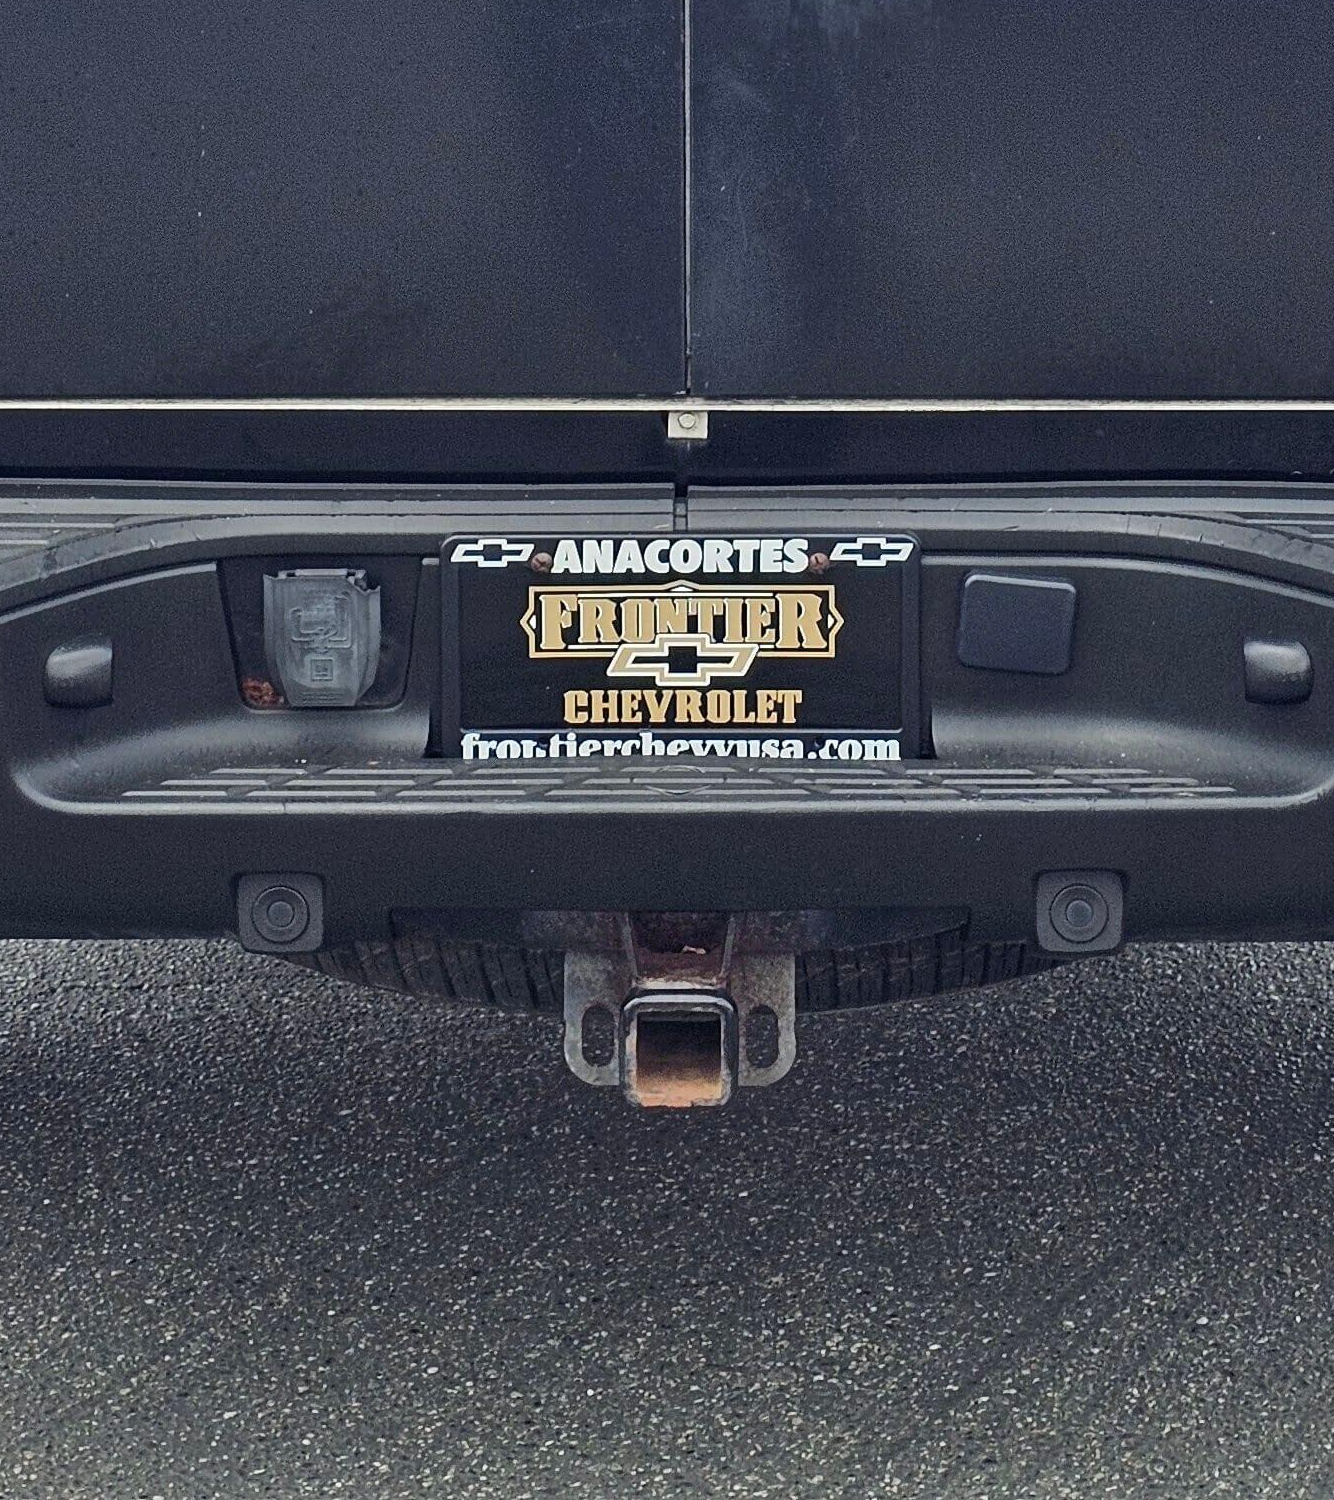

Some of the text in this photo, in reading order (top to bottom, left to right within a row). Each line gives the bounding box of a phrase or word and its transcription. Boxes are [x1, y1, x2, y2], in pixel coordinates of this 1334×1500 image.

[551, 539, 809, 574] ANACORTES
[539, 593, 827, 649] FRONTIER
[563, 689, 803, 724] CHEVROLET
